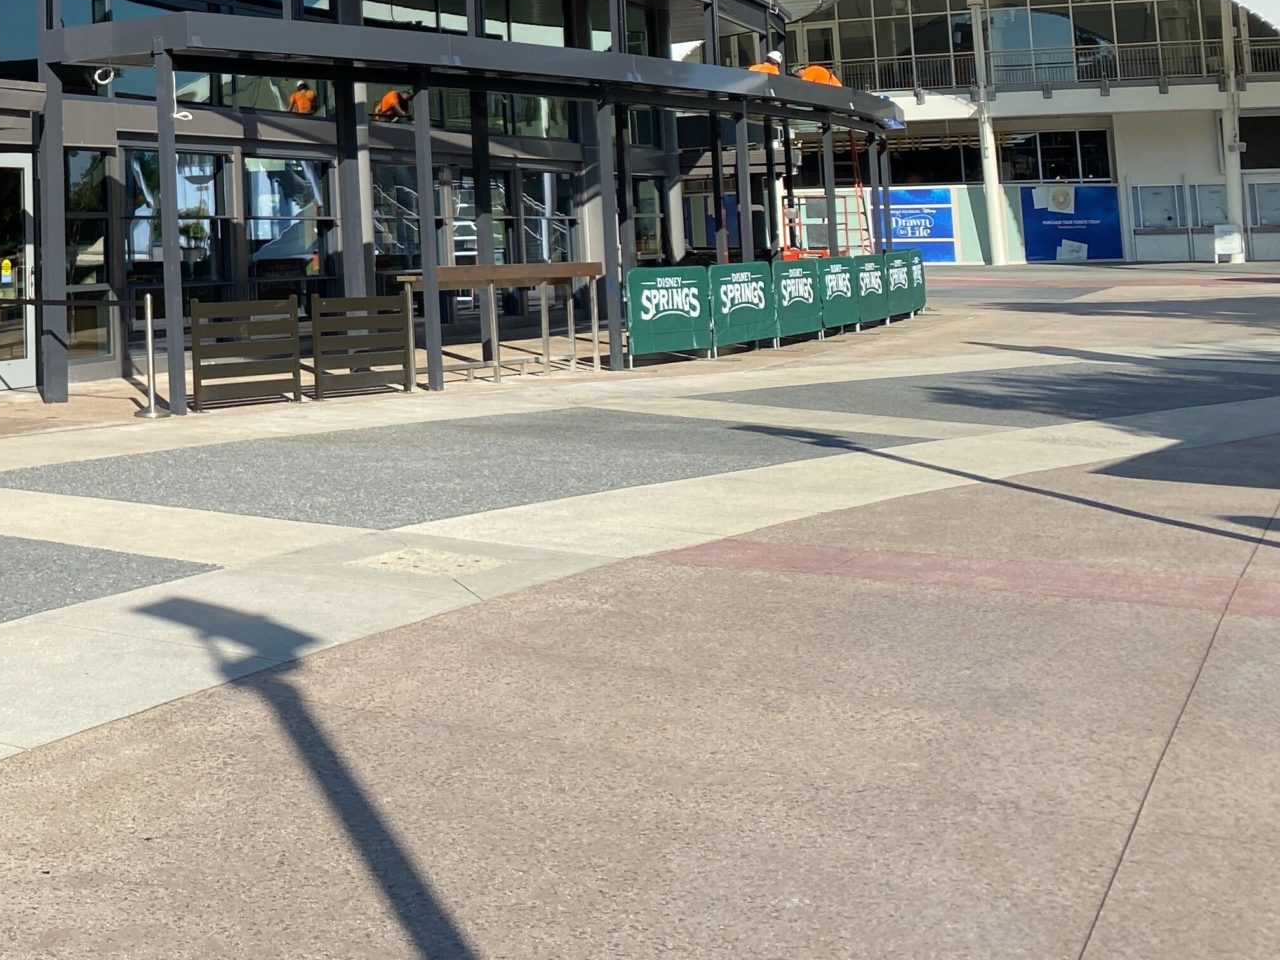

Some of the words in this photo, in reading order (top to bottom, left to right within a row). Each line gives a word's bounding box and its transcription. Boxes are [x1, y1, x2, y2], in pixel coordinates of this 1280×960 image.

[891, 214, 935, 228] Drawn
[907, 226, 931, 237] Life
[656, 277, 682, 288] DISNEY
[731, 272, 752, 283] DISNEY
[720, 281, 765, 314] SPRINGS
[781, 277, 814, 306] SPRINGS
[641, 287, 701, 321] SPRINGS
